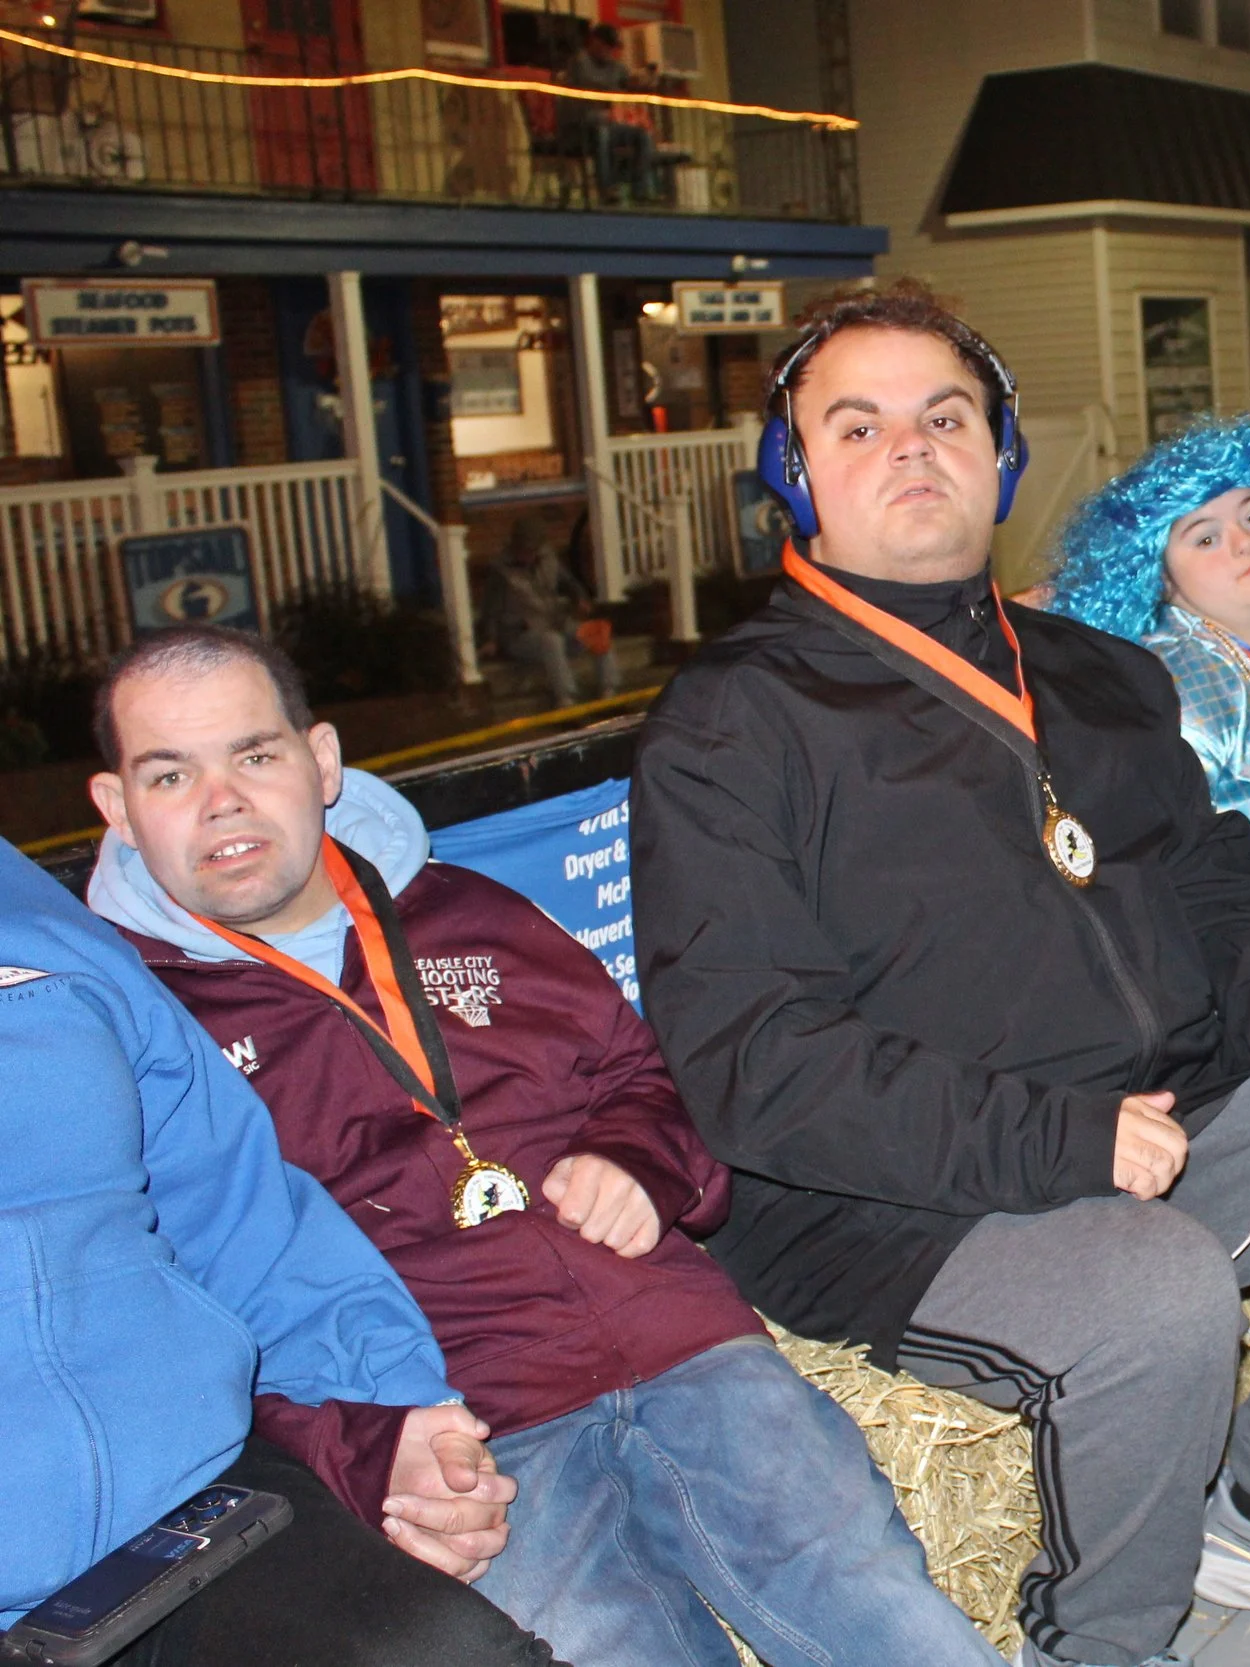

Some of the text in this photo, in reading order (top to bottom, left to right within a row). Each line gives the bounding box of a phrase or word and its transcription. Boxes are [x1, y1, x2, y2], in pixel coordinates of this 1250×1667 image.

[565, 837, 627, 881] Dryer &
[598, 875, 630, 910] McP
[436, 957, 463, 970] ISLE
[464, 956, 492, 969] CITY
[243, 1060, 260, 1075] SIC
